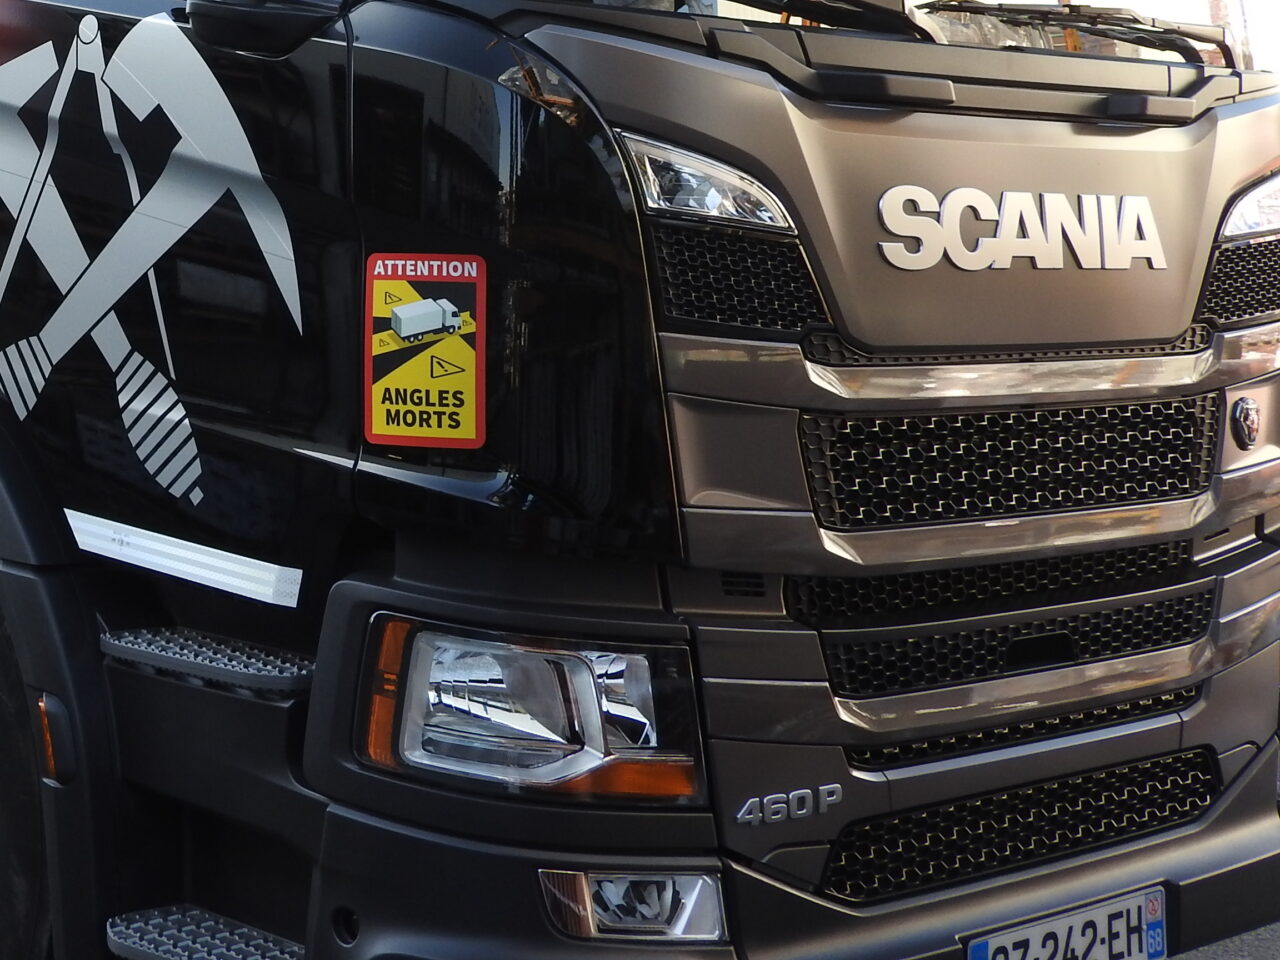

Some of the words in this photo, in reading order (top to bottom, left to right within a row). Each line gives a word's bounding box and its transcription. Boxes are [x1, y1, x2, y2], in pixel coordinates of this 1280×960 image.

[878, 184, 1168, 272] SCANIA
[373, 259, 478, 278] ATTENTION
[381, 387, 465, 409] ANGLES
[385, 408, 461, 430] MORTS
[736, 788, 814, 826] 460
[818, 783, 843, 814] P
[991, 904, 1144, 960] -242-EH
[1147, 927, 1163, 954] 68
